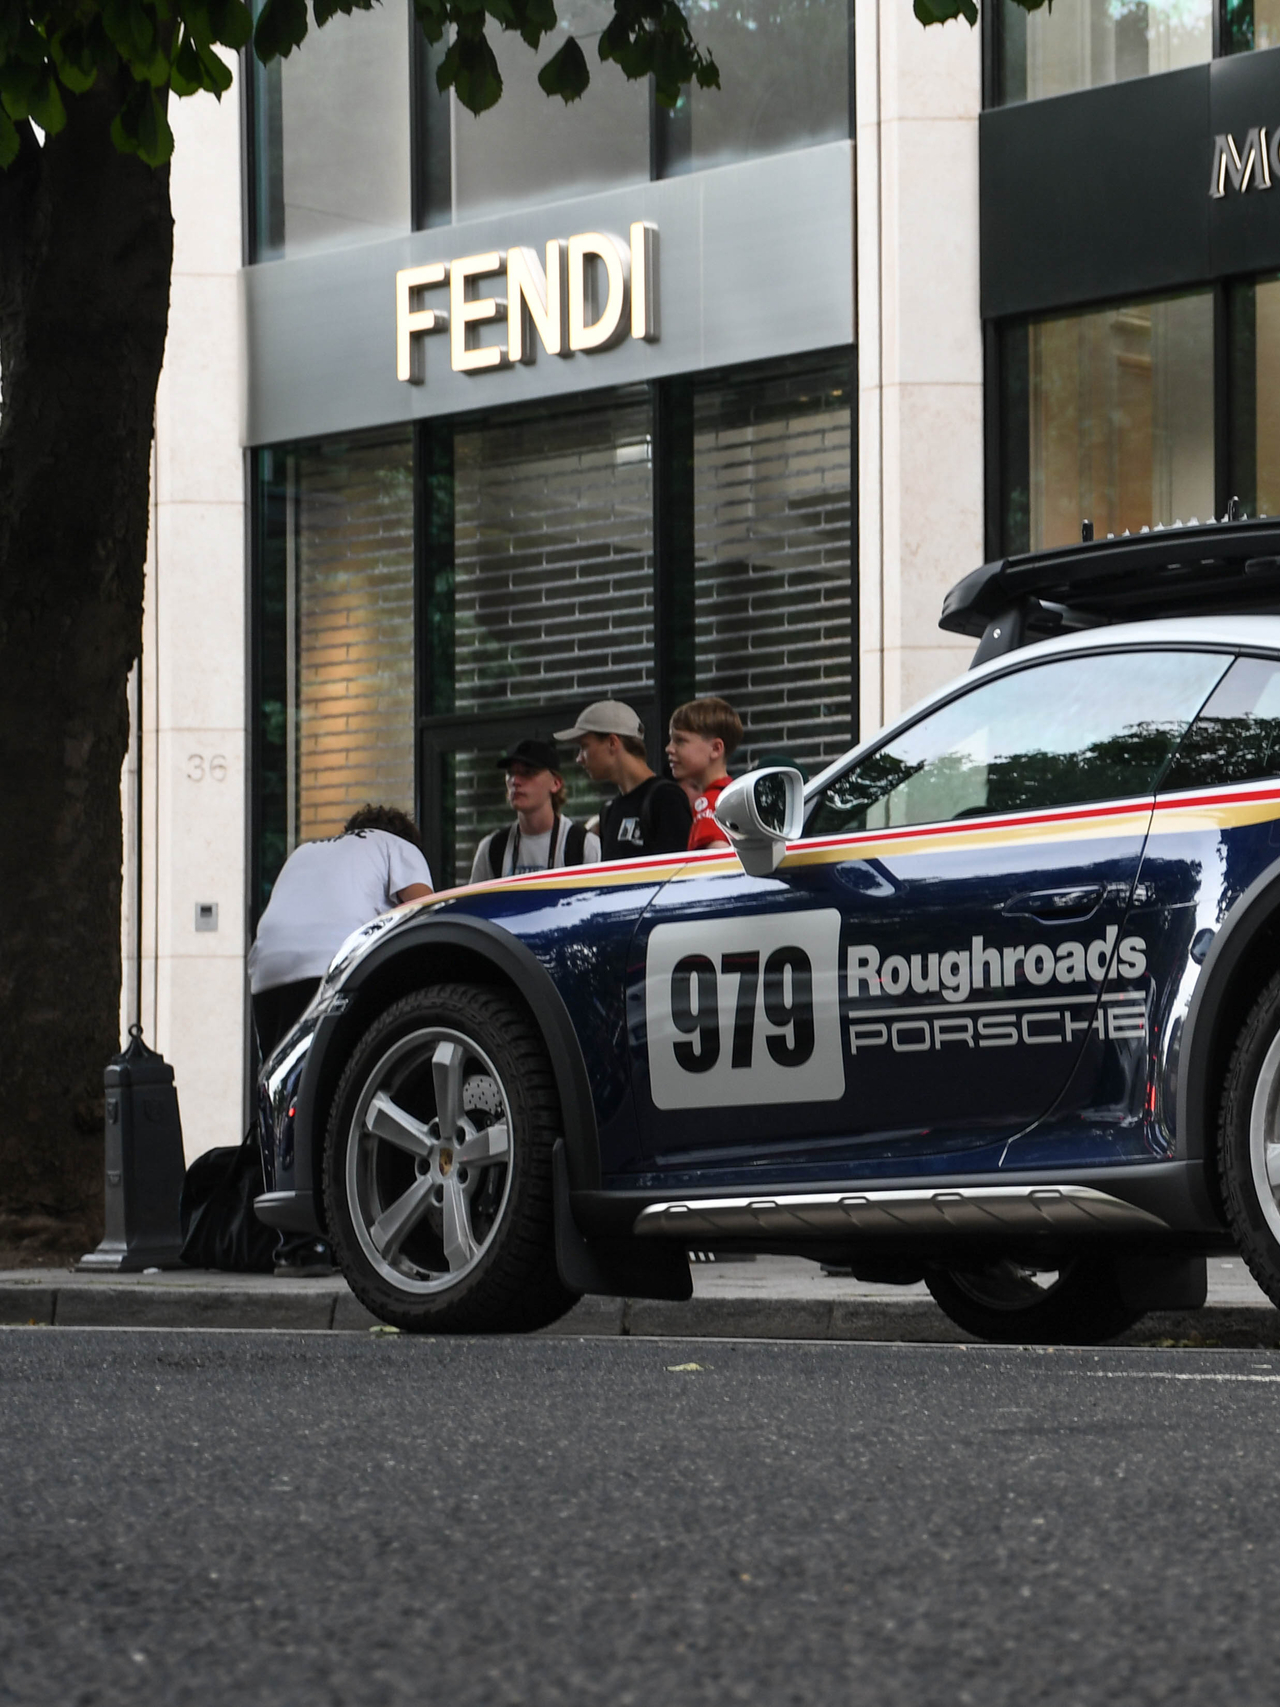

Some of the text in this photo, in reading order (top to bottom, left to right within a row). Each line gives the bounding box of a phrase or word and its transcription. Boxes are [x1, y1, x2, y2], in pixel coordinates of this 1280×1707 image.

[396, 221, 659, 383] FENDI
[187, 753, 227, 783] 36
[847, 924, 1147, 1002] Roughroads
[671, 944, 813, 1074] 979
[849, 1006, 1147, 1055] PORSCHE
